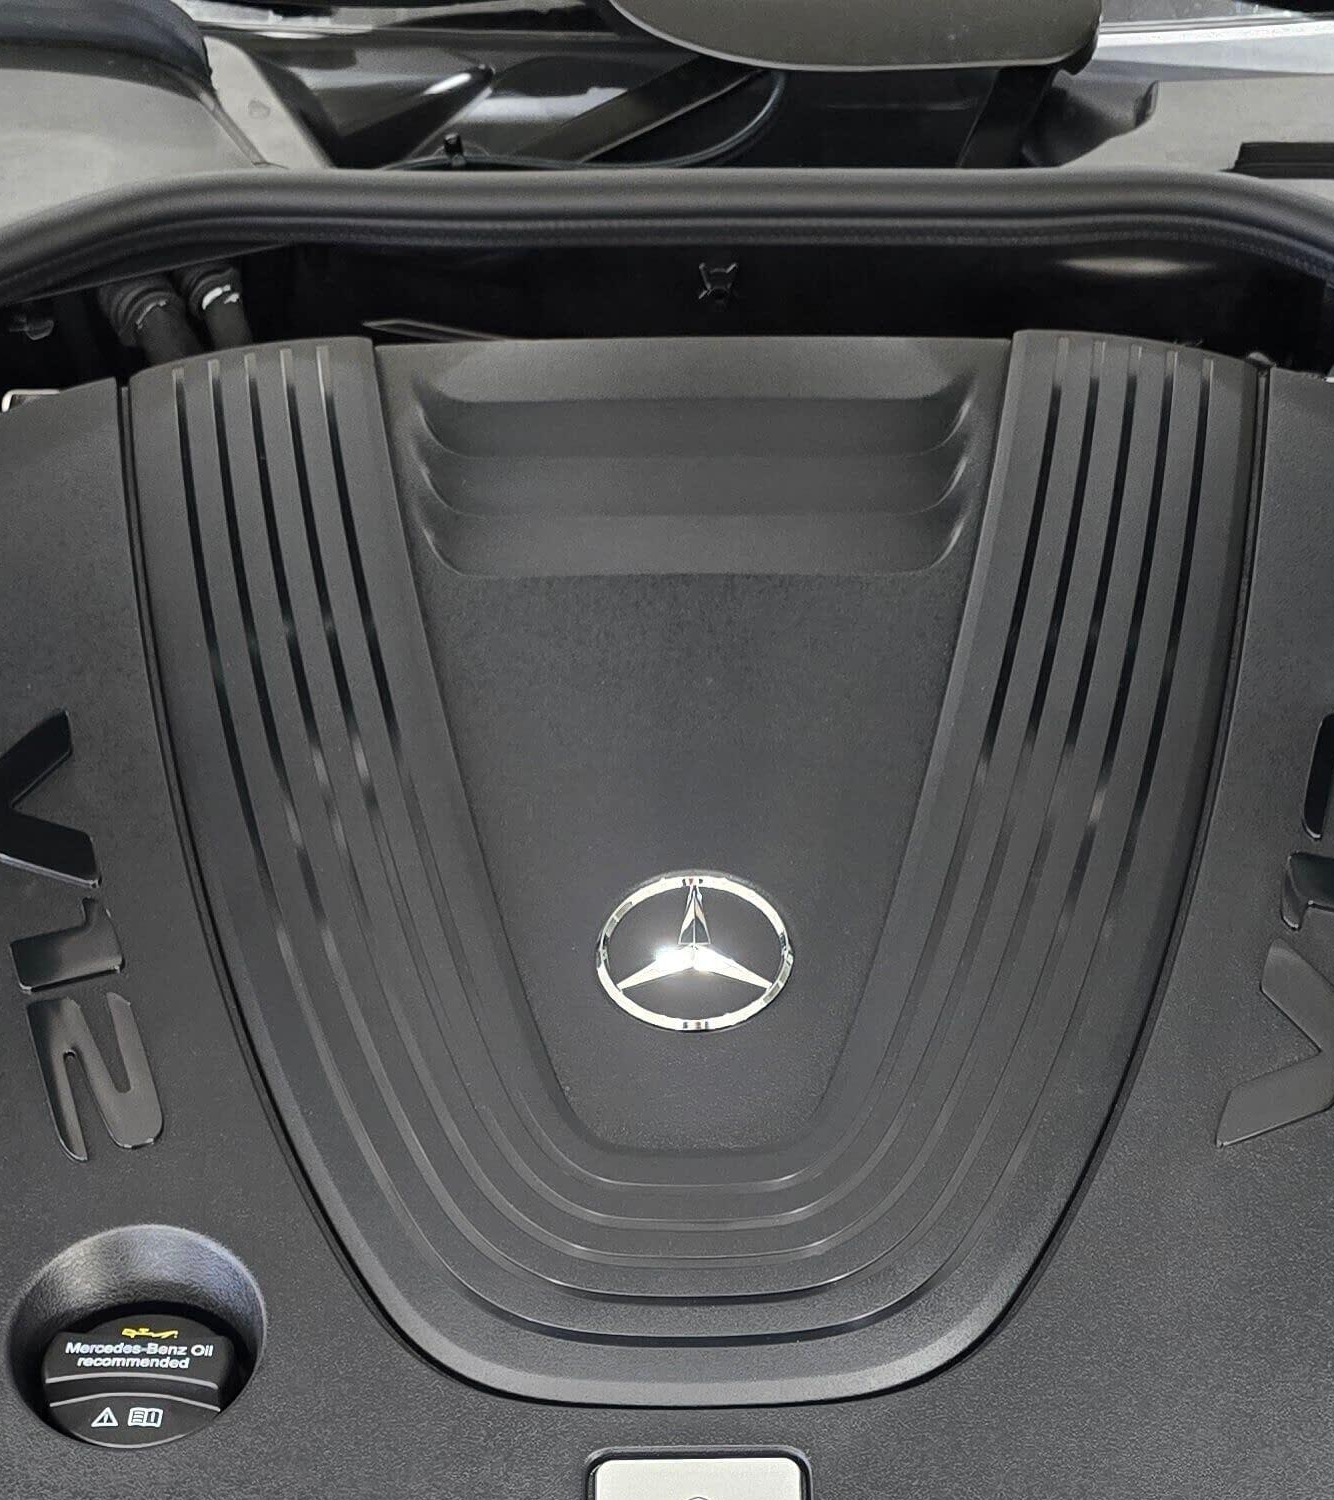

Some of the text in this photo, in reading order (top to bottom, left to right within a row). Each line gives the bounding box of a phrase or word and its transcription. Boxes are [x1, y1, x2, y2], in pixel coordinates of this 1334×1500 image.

[65, 1341, 214, 1357] Mercedes-Benz Oil
[76, 1355, 191, 1369] recommended
